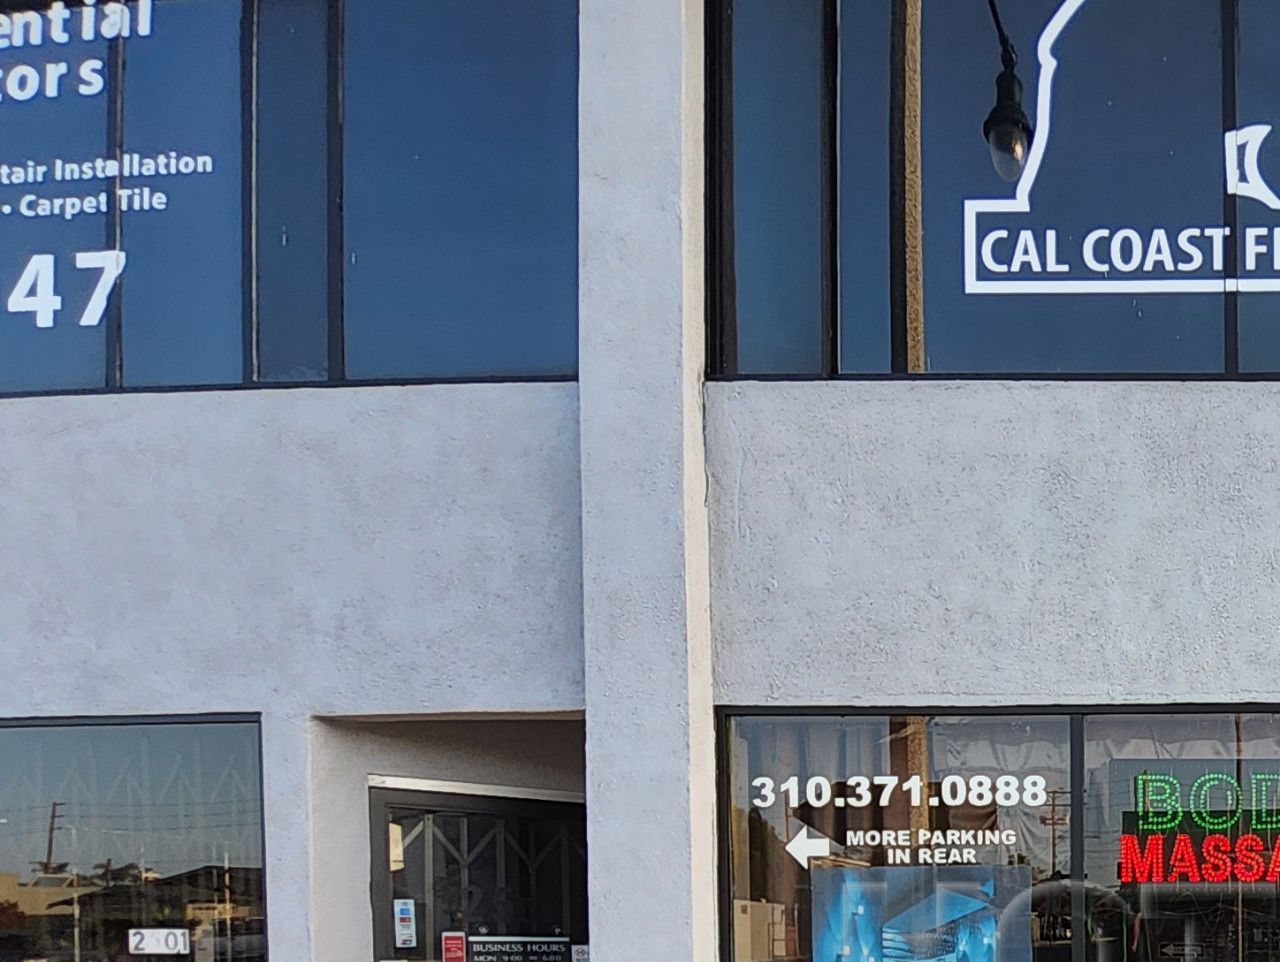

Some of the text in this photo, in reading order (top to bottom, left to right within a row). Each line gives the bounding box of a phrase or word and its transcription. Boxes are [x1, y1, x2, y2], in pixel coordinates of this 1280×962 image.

[0, 58, 104, 101] ors
[0, 152, 213, 184] tair Installation
[20, 187, 167, 219] Carpet Tile
[981, 228, 1069, 274] CAL
[1082, 227, 1230, 273] COAST
[7, 250, 126, 328] 47
[751, 775, 1048, 808] 310.371.0888
[846, 829, 1016, 847] MORE PARKING
[887, 847, 977, 864] IN REAR
[473, 943, 524, 952] BUSINESS
[527, 943, 566, 952] HOURS
